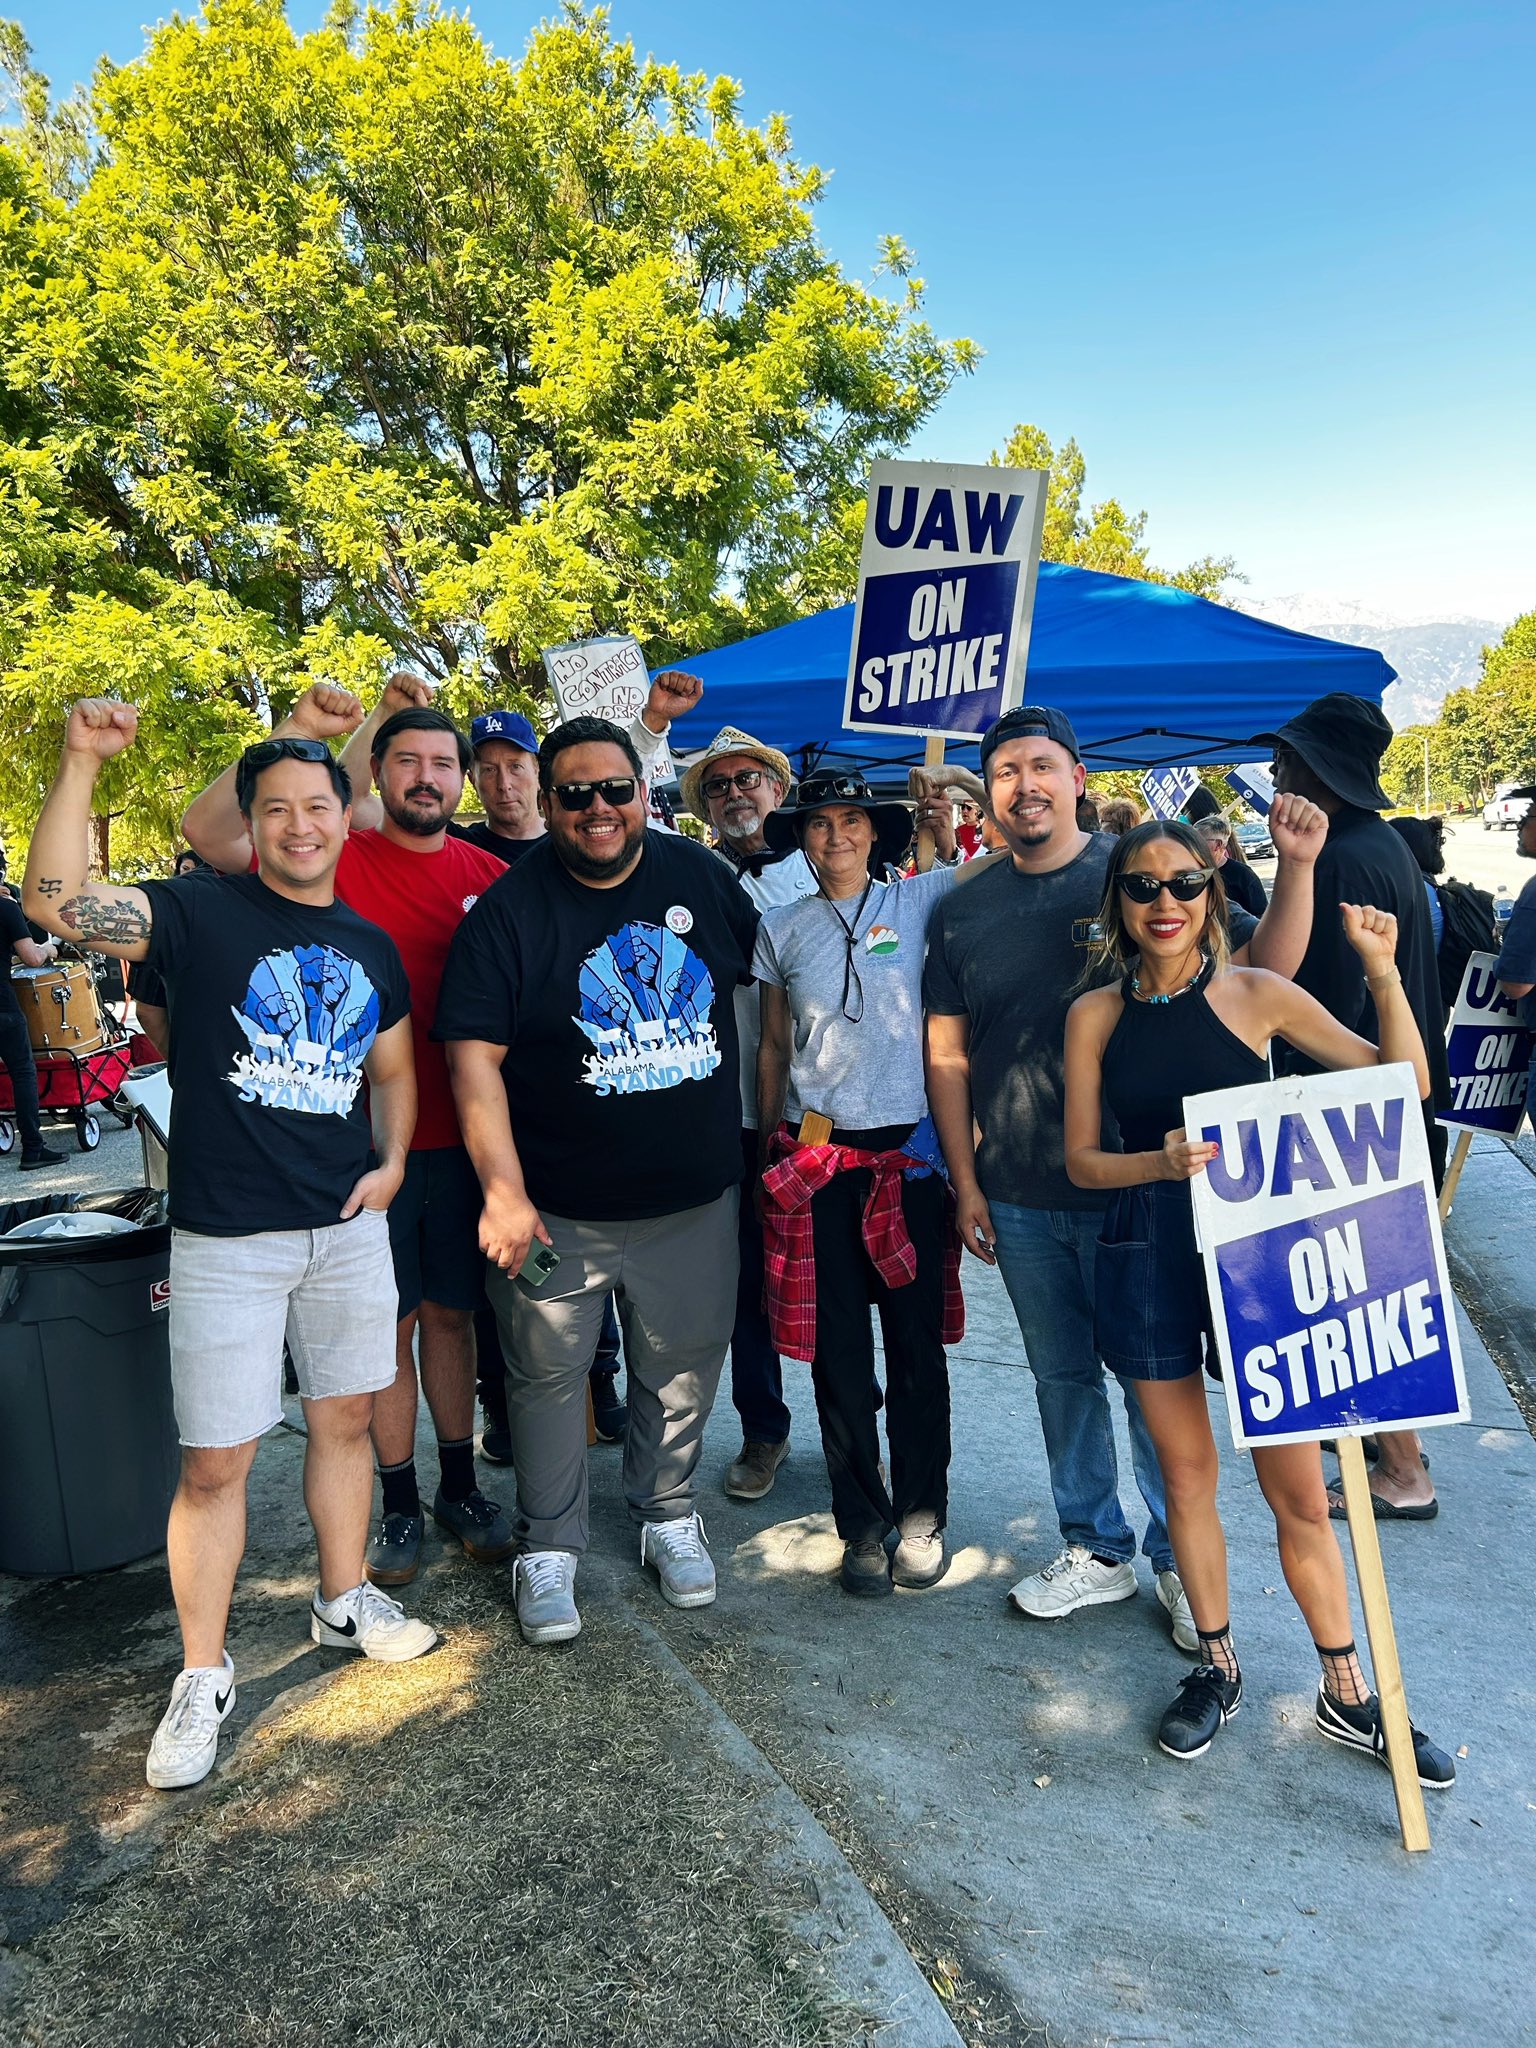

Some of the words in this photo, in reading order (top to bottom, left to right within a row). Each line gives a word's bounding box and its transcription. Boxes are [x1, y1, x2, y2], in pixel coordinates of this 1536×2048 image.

[875, 485, 1025, 556] UAW
[908, 577, 967, 642] ON
[563, 643, 643, 707] CONTRACT
[858, 633, 1003, 713] STRIKE
[612, 686, 645, 705] NO
[485, 716, 503, 733] LA
[1144, 776, 1177, 820] STRIKE
[1161, 774, 1178, 797] ON
[604, 1062, 656, 1077] ALABAMA
[1475, 1033, 1518, 1071] ON
[253, 1073, 312, 1091] ALABAMA
[595, 1065, 684, 1096] STAND
[690, 1055, 717, 1081] UP
[1201, 1097, 1405, 1203] UAW
[1288, 1218, 1369, 1315] ON
[1243, 1278, 1441, 1423] STRIKE
